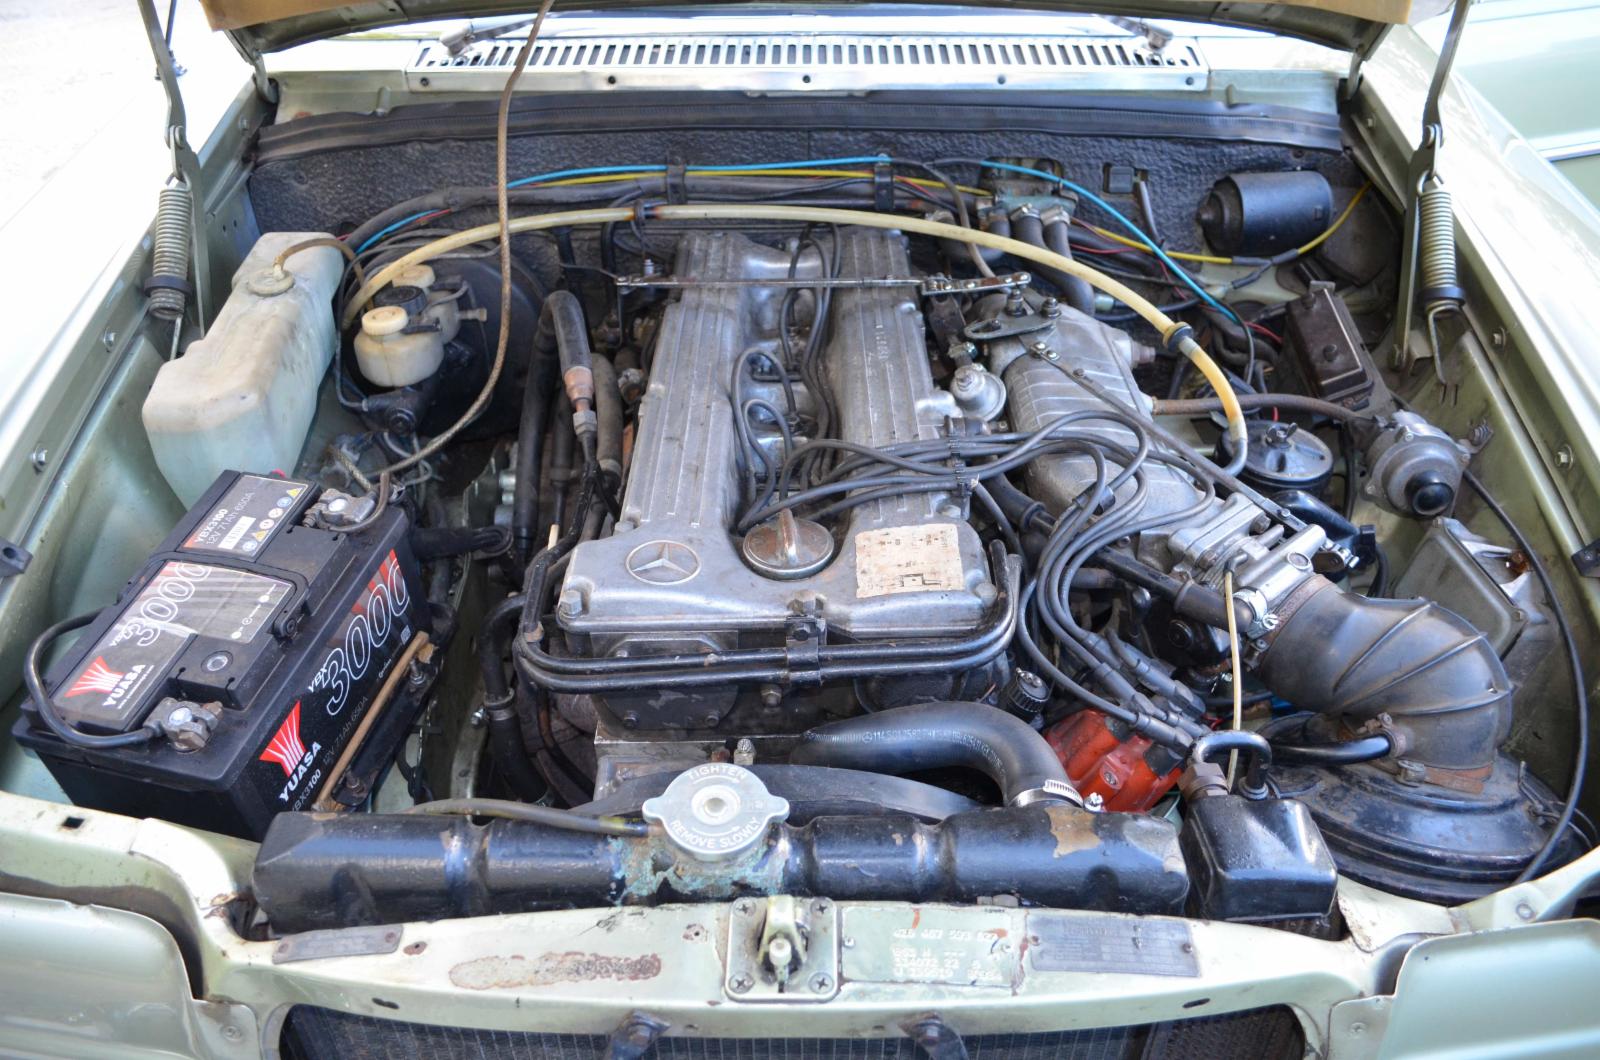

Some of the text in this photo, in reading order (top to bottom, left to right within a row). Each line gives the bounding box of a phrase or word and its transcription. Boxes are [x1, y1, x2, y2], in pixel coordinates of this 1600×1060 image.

[195, 508, 228, 543] YBX3100
[206, 531, 222, 545] 12V
[123, 562, 212, 647] 3000
[320, 557, 410, 717] 3000
[102, 664, 146, 707] YUASA
[307, 666, 328, 694] YBX
[278, 740, 322, 803] YUASA
[687, 765, 748, 781] TIGHTEN
[671, 816, 761, 849] REMOVE SLOWLY
